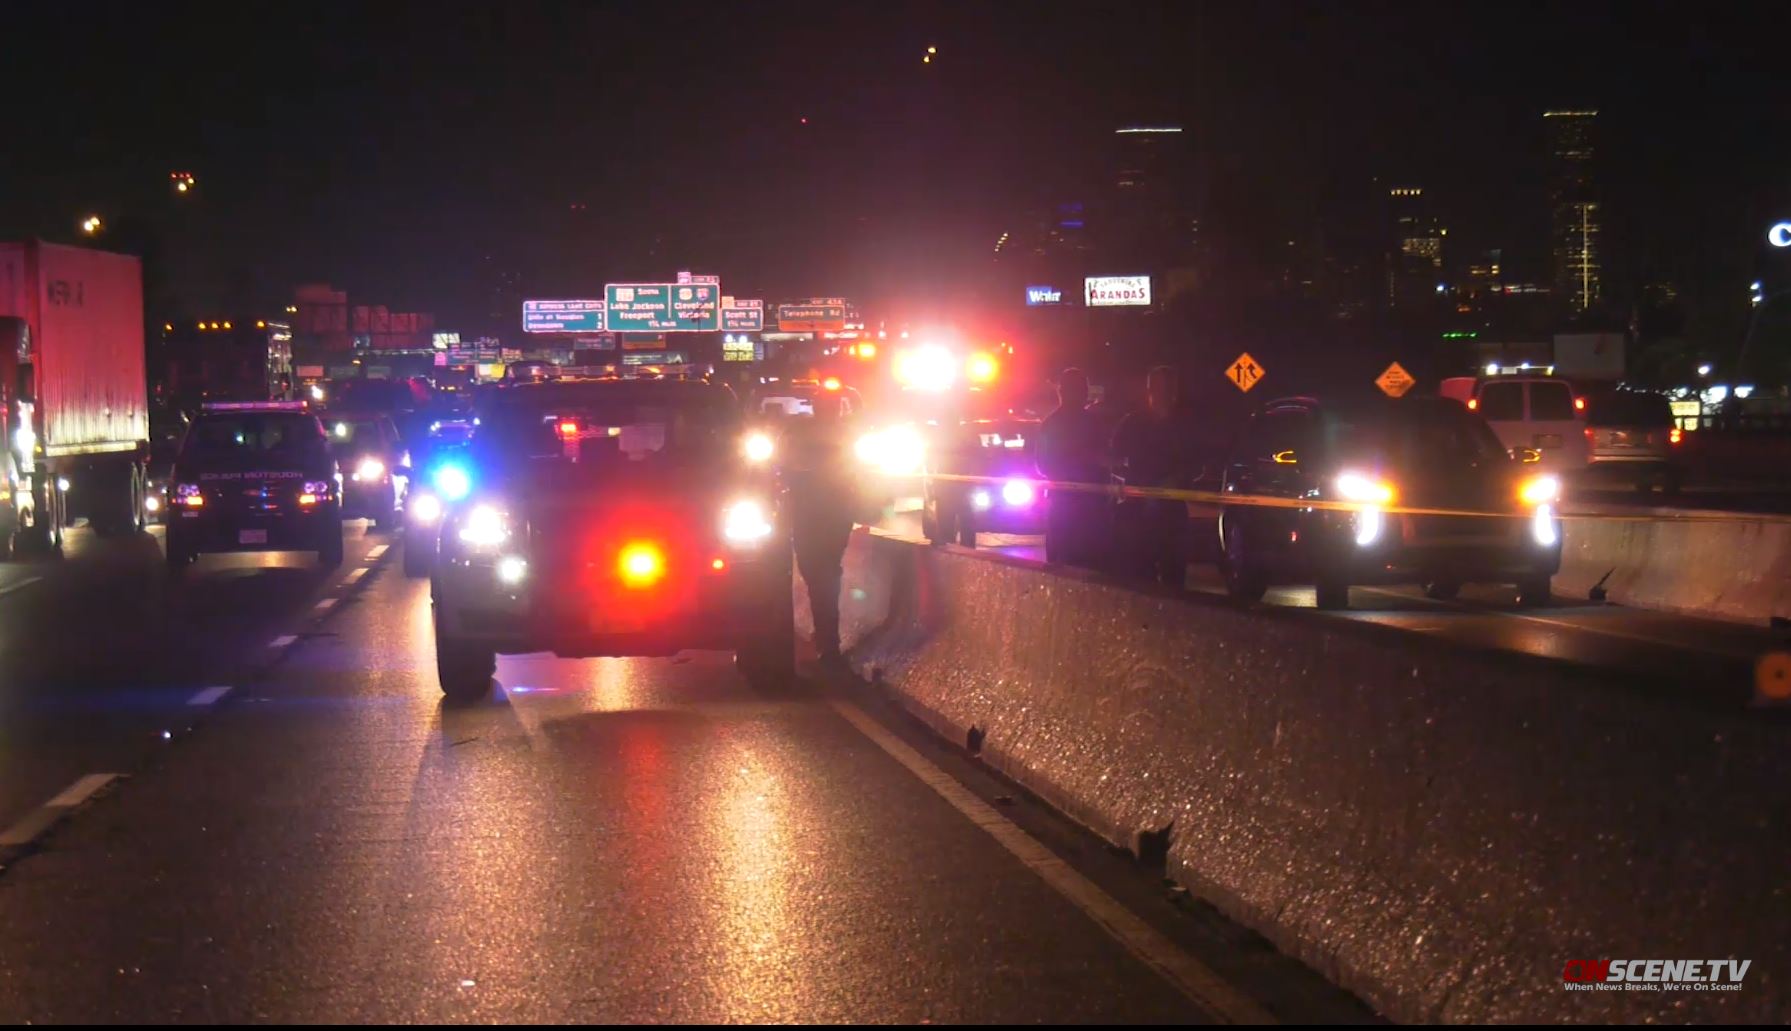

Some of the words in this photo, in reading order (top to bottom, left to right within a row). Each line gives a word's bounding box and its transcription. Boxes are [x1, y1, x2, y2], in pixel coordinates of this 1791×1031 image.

[1091, 287, 1146, 299] ARANDAS
[609, 302, 630, 310] Lake
[632, 302, 666, 310] Jackson
[673, 302, 715, 310] Cleveland
[620, 312, 655, 320] Freeport
[725, 311, 746, 319] Scott
[783, 310, 824, 318] Telephone
